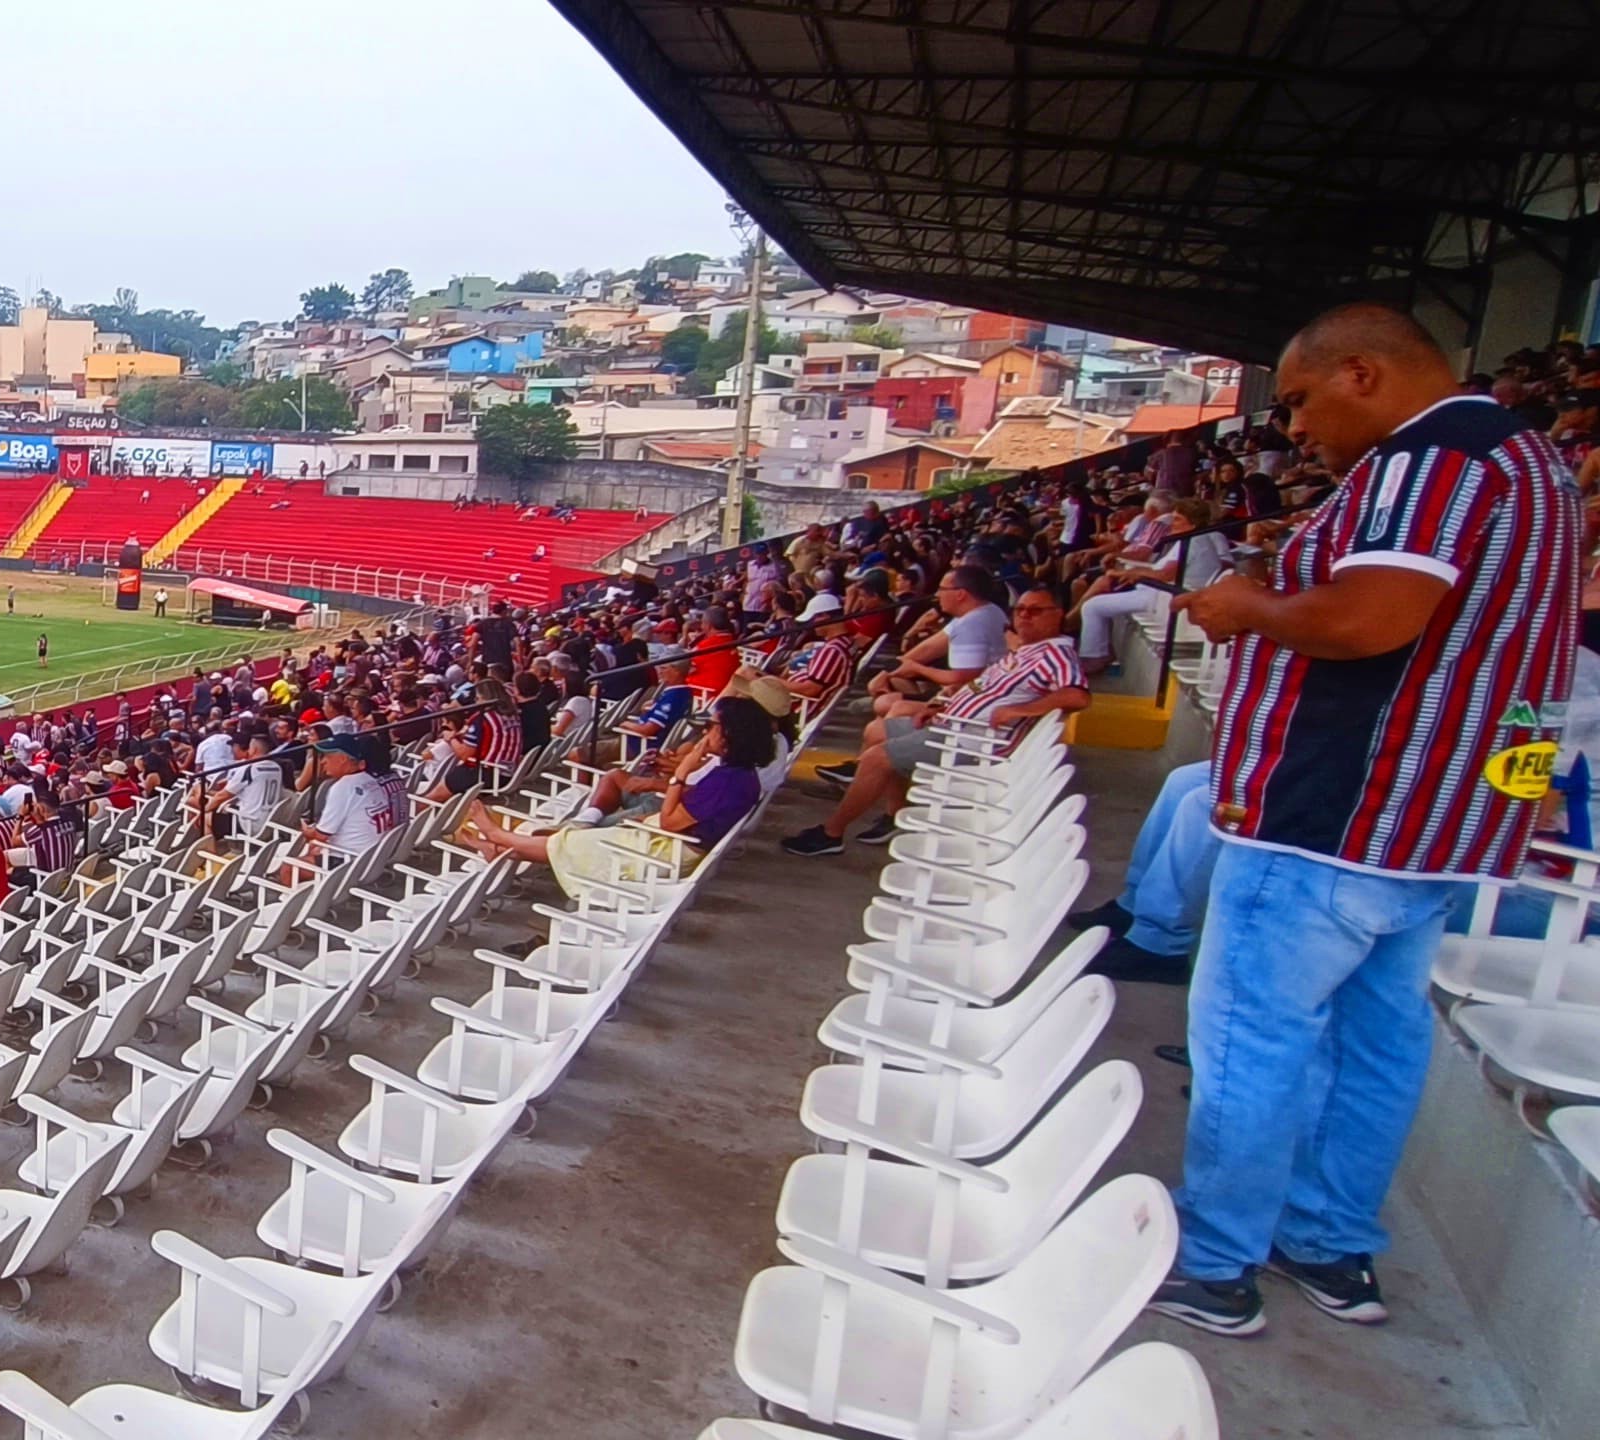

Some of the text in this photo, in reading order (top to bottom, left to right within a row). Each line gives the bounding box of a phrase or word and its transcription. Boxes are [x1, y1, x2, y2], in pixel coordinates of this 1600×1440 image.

[9, 440, 48, 459] Boa
[131, 447, 168, 462] G2G
[1518, 751, 1556, 777] FUE
[262, 778, 279, 806] 10
